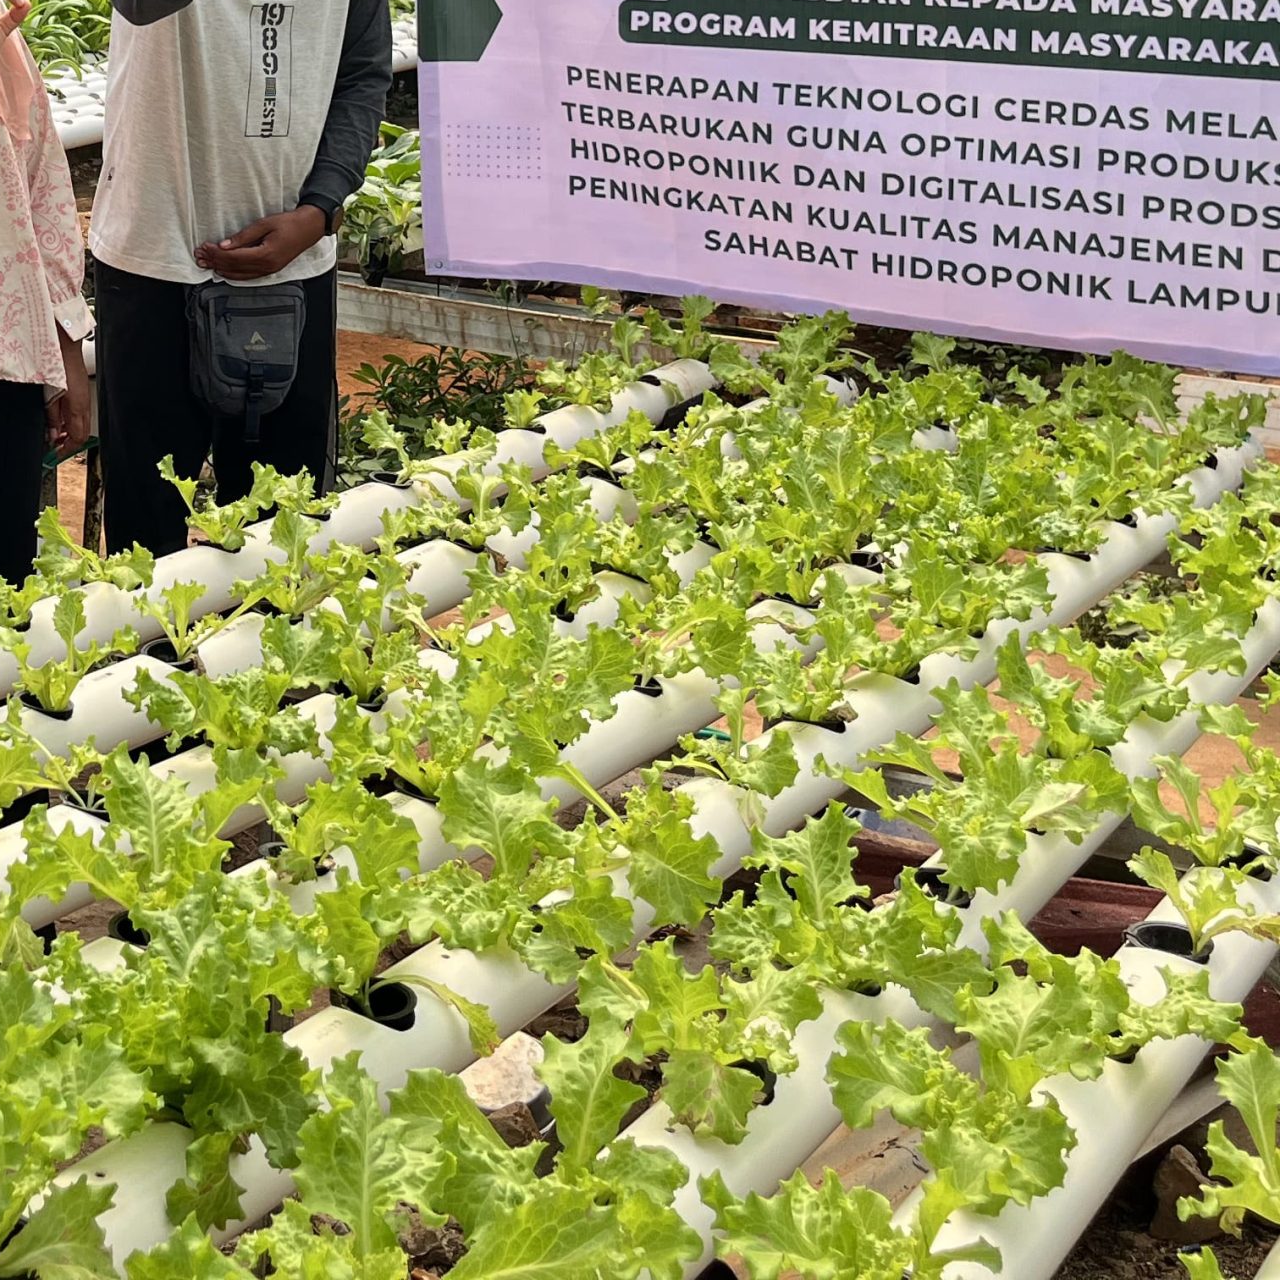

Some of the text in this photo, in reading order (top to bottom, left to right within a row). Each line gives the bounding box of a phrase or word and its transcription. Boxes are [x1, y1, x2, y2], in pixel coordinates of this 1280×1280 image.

[630, 10, 1280, 67] PROGRAM KEMITRAAN MASYARAKA
[561, 101, 772, 145] TERBARUKAN
[786, 125, 887, 154] GUNA
[900, 133, 1081, 170] OPTIMASI
[566, 65, 1278, 141] PENERAPAN TEKNOLOGI CERDAS MELA
[569, 175, 793, 224] PENINGKATAN
[807, 204, 978, 245] KUALITAS
[993, 224, 1243, 271] MANAJEMEN
[570, 138, 1280, 230] HIDROPONIIK DAN DIGITALISASI PRODS
[704, 229, 1280, 316] SAHABAT HIDROPONIK LAMPU
